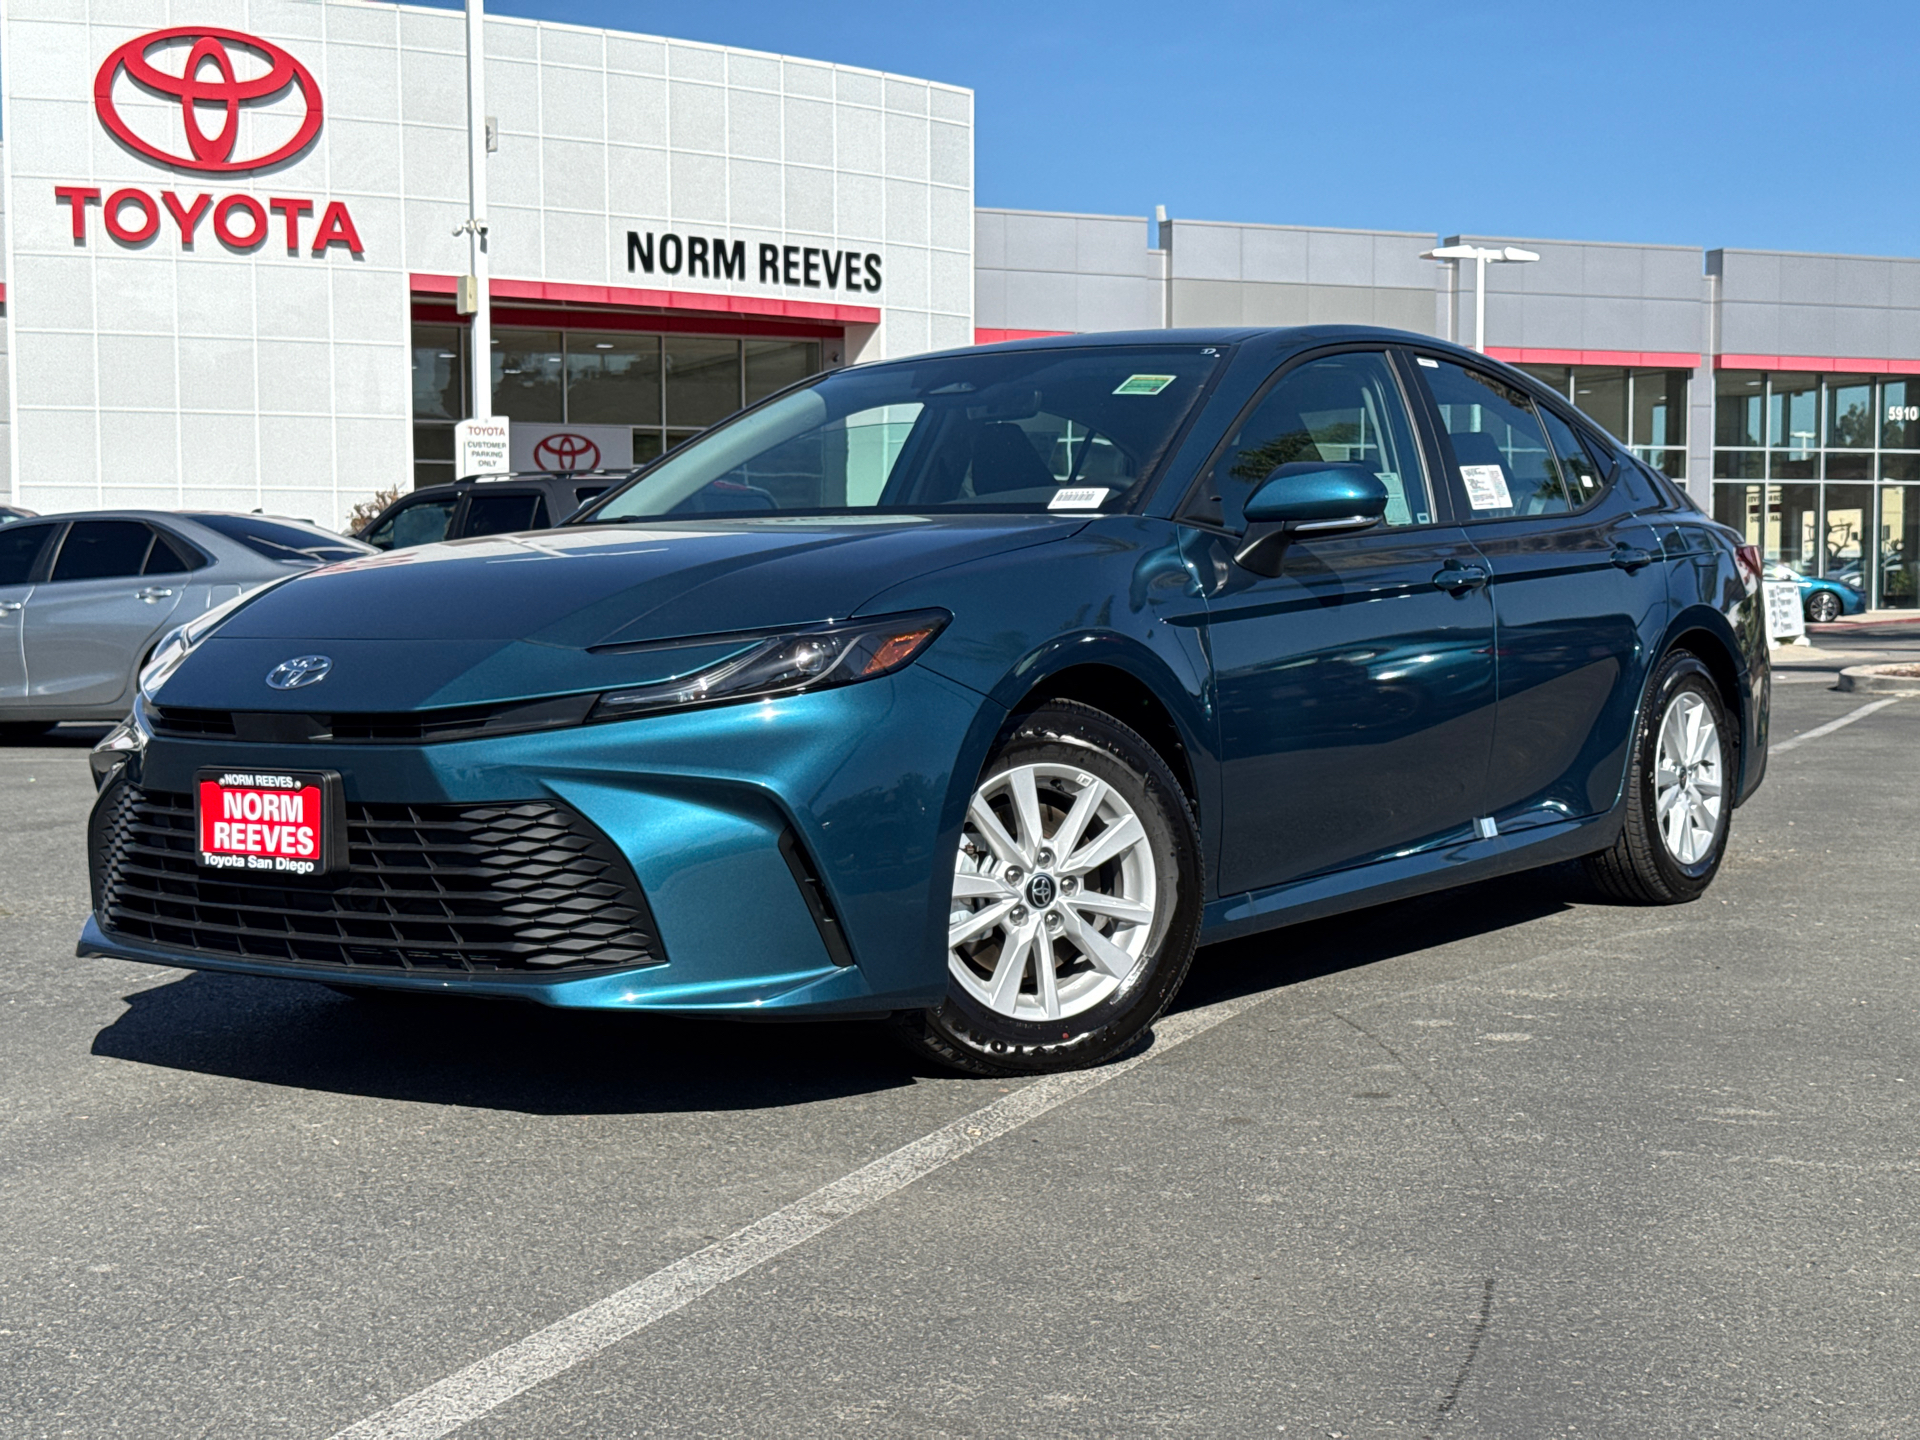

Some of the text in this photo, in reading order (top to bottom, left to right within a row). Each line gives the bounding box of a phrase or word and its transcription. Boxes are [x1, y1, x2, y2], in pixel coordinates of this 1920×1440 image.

[55, 186, 364, 254] TOYOTA
[627, 231, 882, 293] NORM REEVES
[1888, 405, 1919, 421] 5910
[468, 426, 506, 436] TOYOTA
[467, 441, 506, 449] CUSTOMER
[471, 450, 503, 458] PARKING
[478, 459, 497, 467] ONLY
[224, 773, 293, 788] NORM REEVES
[223, 791, 304, 823] NORM
[213, 821, 314, 856] REEVES
[202, 852, 315, 874] Toyota San Diego
